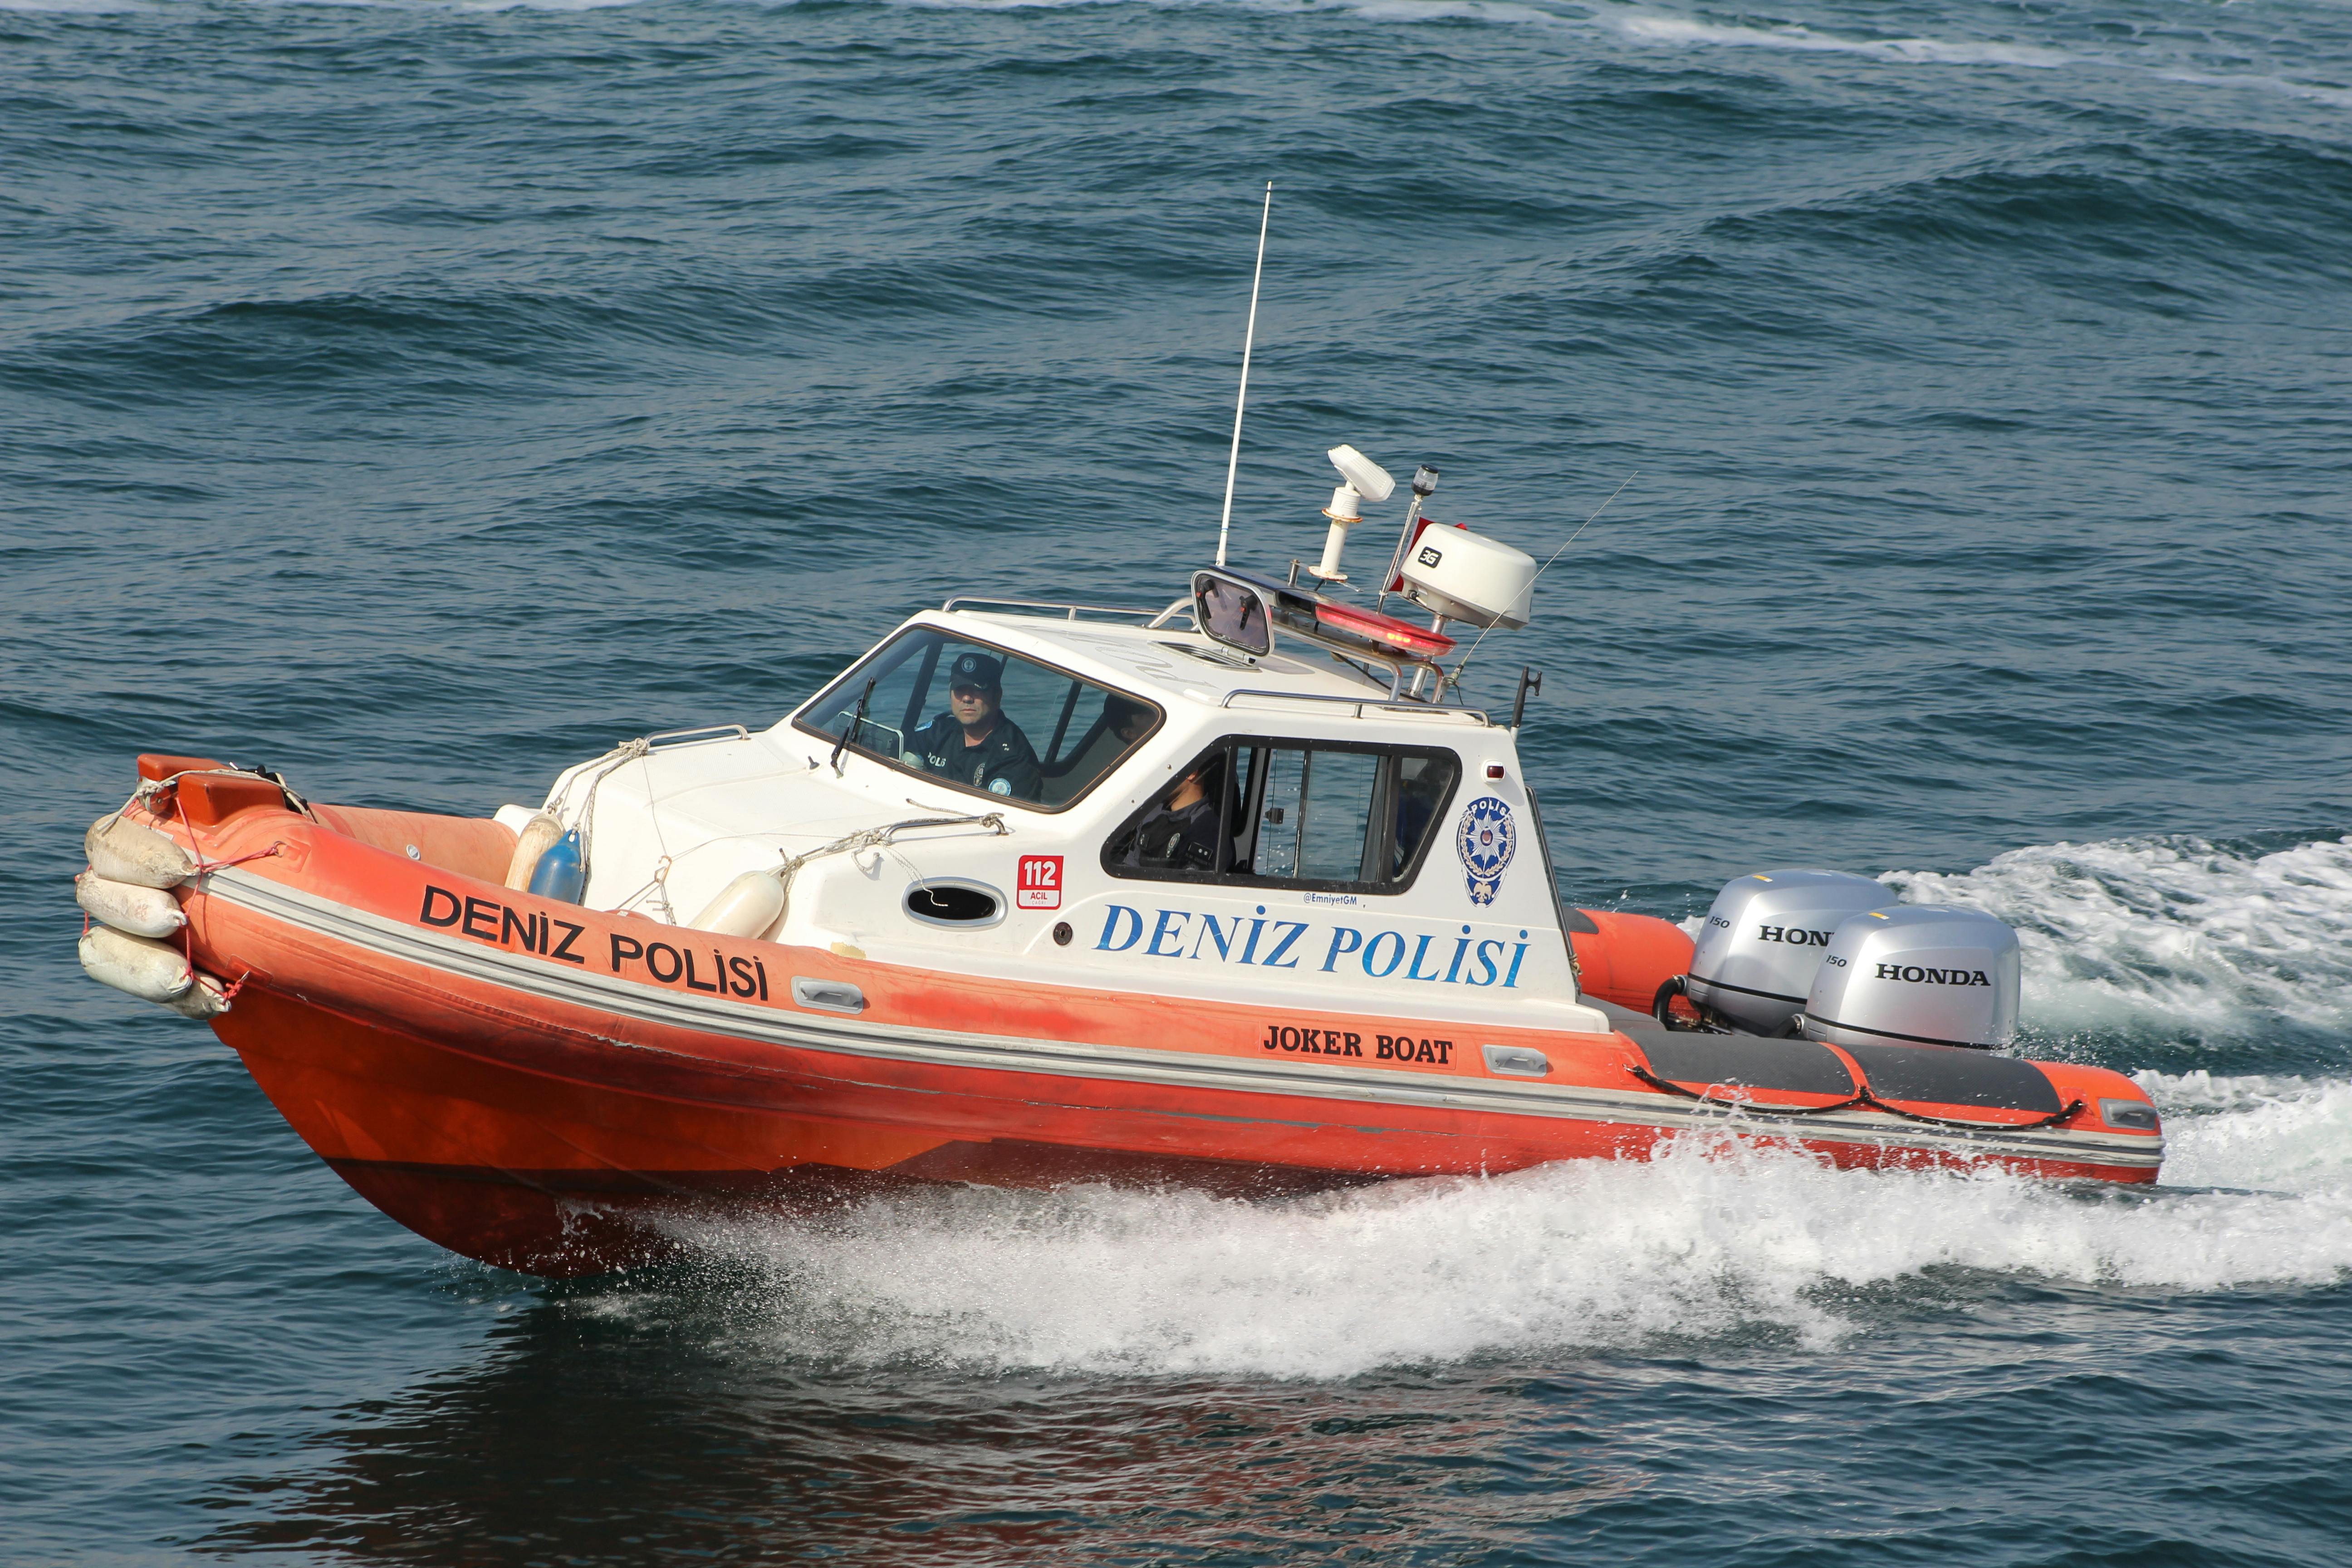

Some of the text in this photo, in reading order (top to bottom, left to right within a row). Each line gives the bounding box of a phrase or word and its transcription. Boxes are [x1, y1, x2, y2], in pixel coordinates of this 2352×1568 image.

[1420, 550, 1439, 564] 3G
[1024, 861, 1056, 886] 112
[1303, 892, 1357, 906] @EmniyetGM
[1710, 916, 1730, 928] 150
[420, 884, 768, 1001] DENİZ POLİSİ
[1092, 905, 1531, 988] DENİZ POLİSİ
[1758, 925, 1835, 947] HON
[1826, 955, 1847, 967] 150
[1875, 963, 1991, 987] HONDA
[1264, 1025, 1453, 1064] JOKER BOAT
